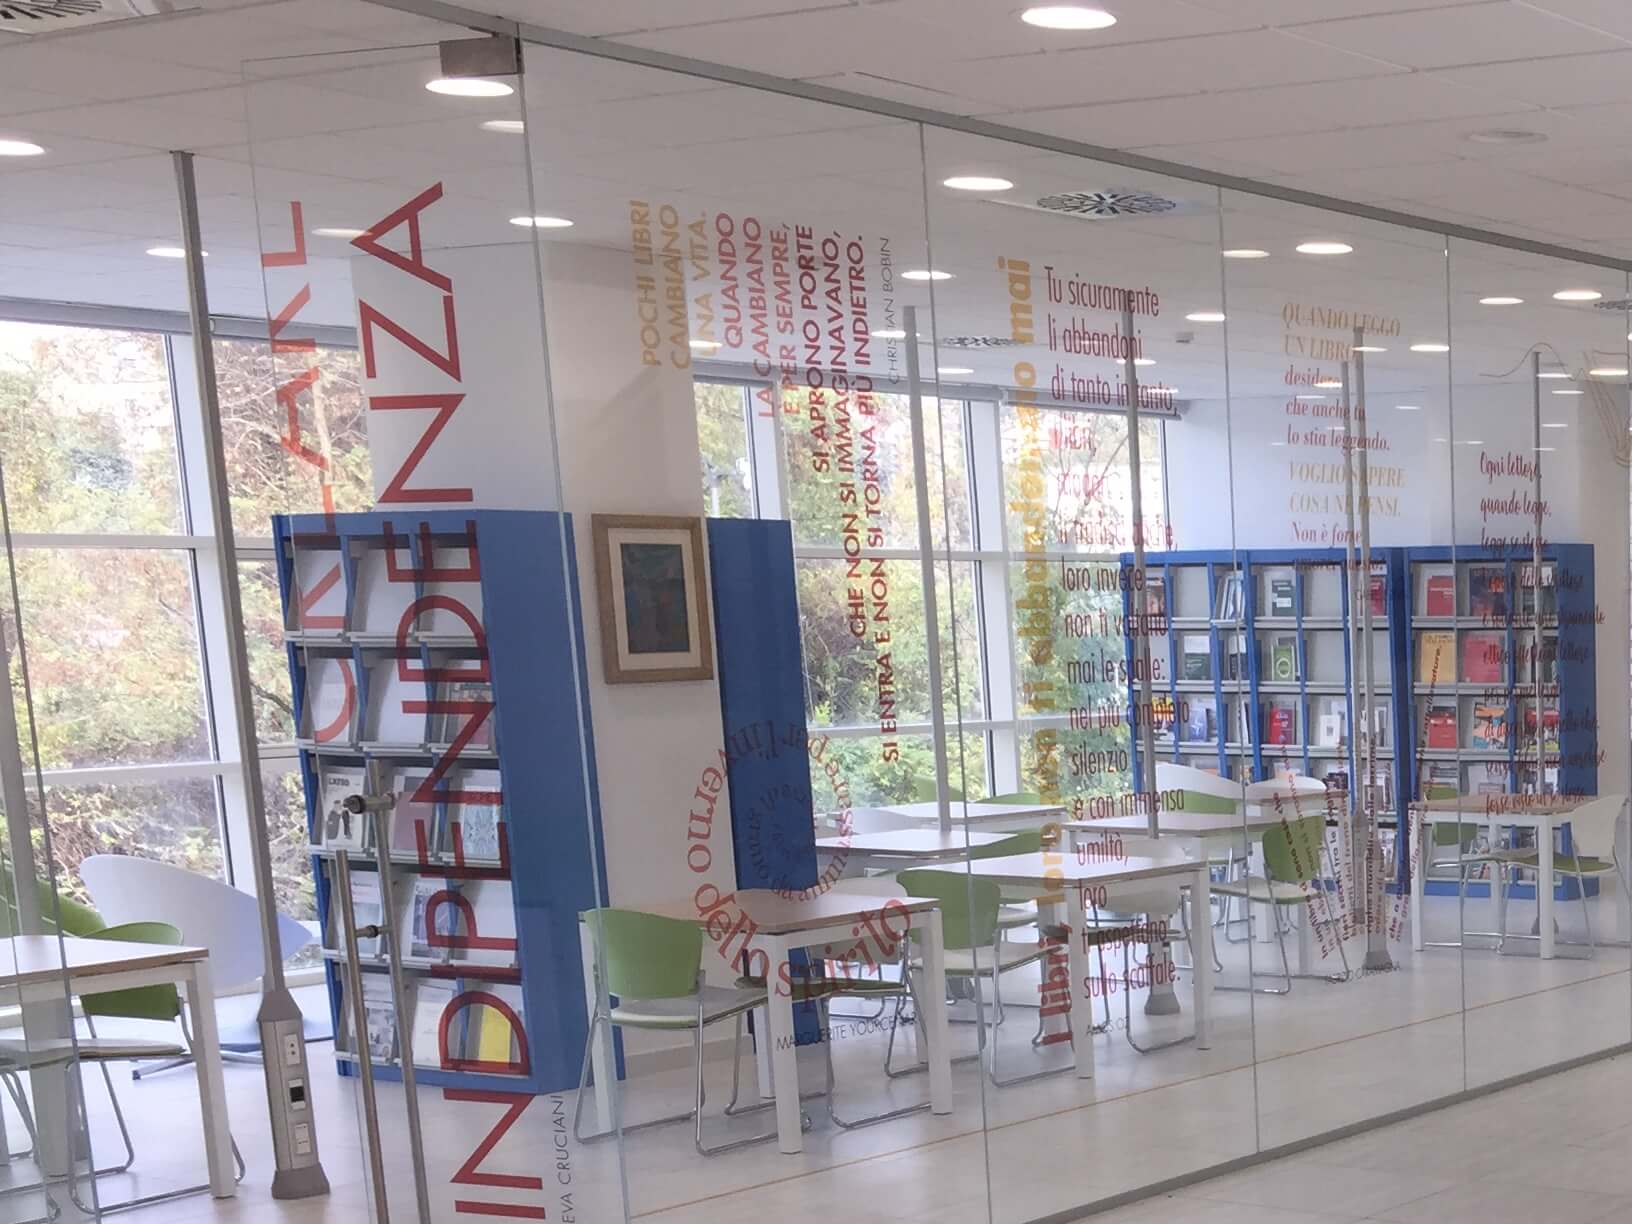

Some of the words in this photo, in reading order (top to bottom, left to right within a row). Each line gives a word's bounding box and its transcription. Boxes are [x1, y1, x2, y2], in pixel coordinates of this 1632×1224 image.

[630, 200, 654, 265] LIBRI
[688, 211, 711, 281] VITA.
[659, 204, 691, 369] CAMBIANO
[715, 213, 743, 348] QUANDO
[770, 223, 796, 336] SEMPRE,
[796, 225, 819, 310] PORTE
[879, 237, 894, 292] BOBIN
[743, 217, 771, 377] CAMBIANO
[847, 235, 872, 366] INDIETRO.
[996, 256, 1035, 343] mai
[1044, 266, 1063, 303] Tu
[1068, 272, 1160, 317] sicuramente
[1282, 302, 1349, 329] QUANDO
[636, 275, 661, 367] POCHI
[693, 293, 719, 358] UNA
[882, 298, 901, 386] CHRISTIAN
[1048, 314, 1057, 351] li
[1063, 317, 1144, 360] abbandoni
[1285, 334, 1306, 357] UN
[779, 345, 800, 394] PER
[821, 231, 855, 473] IMMAGINAVANO,
[755, 384, 775, 418] LA
[802, 319, 829, 442] APRONO
[1051, 364, 1065, 401] di
[1071, 371, 1111, 405] tanto
[1116, 374, 1130, 407] in
[1286, 397, 1308, 416] che
[1312, 398, 1350, 421] anche
[812, 452, 830, 473] SI
[1287, 424, 1300, 445] lo
[1304, 427, 1327, 447] stia
[1331, 429, 1390, 457] leggendo.
[860, 426, 881, 518] TORNA
[1480, 450, 1506, 484] Ogni
[840, 483, 857, 506] SI
[1480, 488, 1520, 523] quando
[1523, 491, 1552, 526] legge,
[842, 513, 862, 578] NON
[868, 528, 884, 548] SI
[1291, 521, 1317, 543] Non
[1321, 523, 1329, 544] è
[1331, 523, 1361, 549] forse
[870, 558, 890, 622] NON
[1061, 555, 1091, 593] loro
[1097, 560, 1143, 592] invece
[847, 588, 866, 637] CHE
[875, 630, 890, 643] E
[1065, 614, 1094, 638] non
[1100, 607, 1110, 636] ti
[1114, 602, 1168, 638] voltano
[1067, 652, 1096, 684] mai
[1101, 649, 1115, 681] le
[350, 181, 547, 1220] INDIPENDENZA
[876, 652, 897, 733] ENTRA
[1069, 695, 1093, 731] nel
[1099, 698, 1121, 736] più
[1127, 694, 1190, 732] completo
[883, 742, 899, 763] SI
[1072, 741, 1128, 777] silenzio
[1090, 796, 1115, 820] con
[1120, 789, 1185, 817] immensa
[1079, 879, 1107, 911] loro
[695, 883, 771, 975] dello
[775, 899, 914, 1007] spirito
[1124, 954, 1181, 993] scaffale.
[551, 1095, 571, 1185] CRUCIANI
[562, 1193, 576, 1223] EVA
